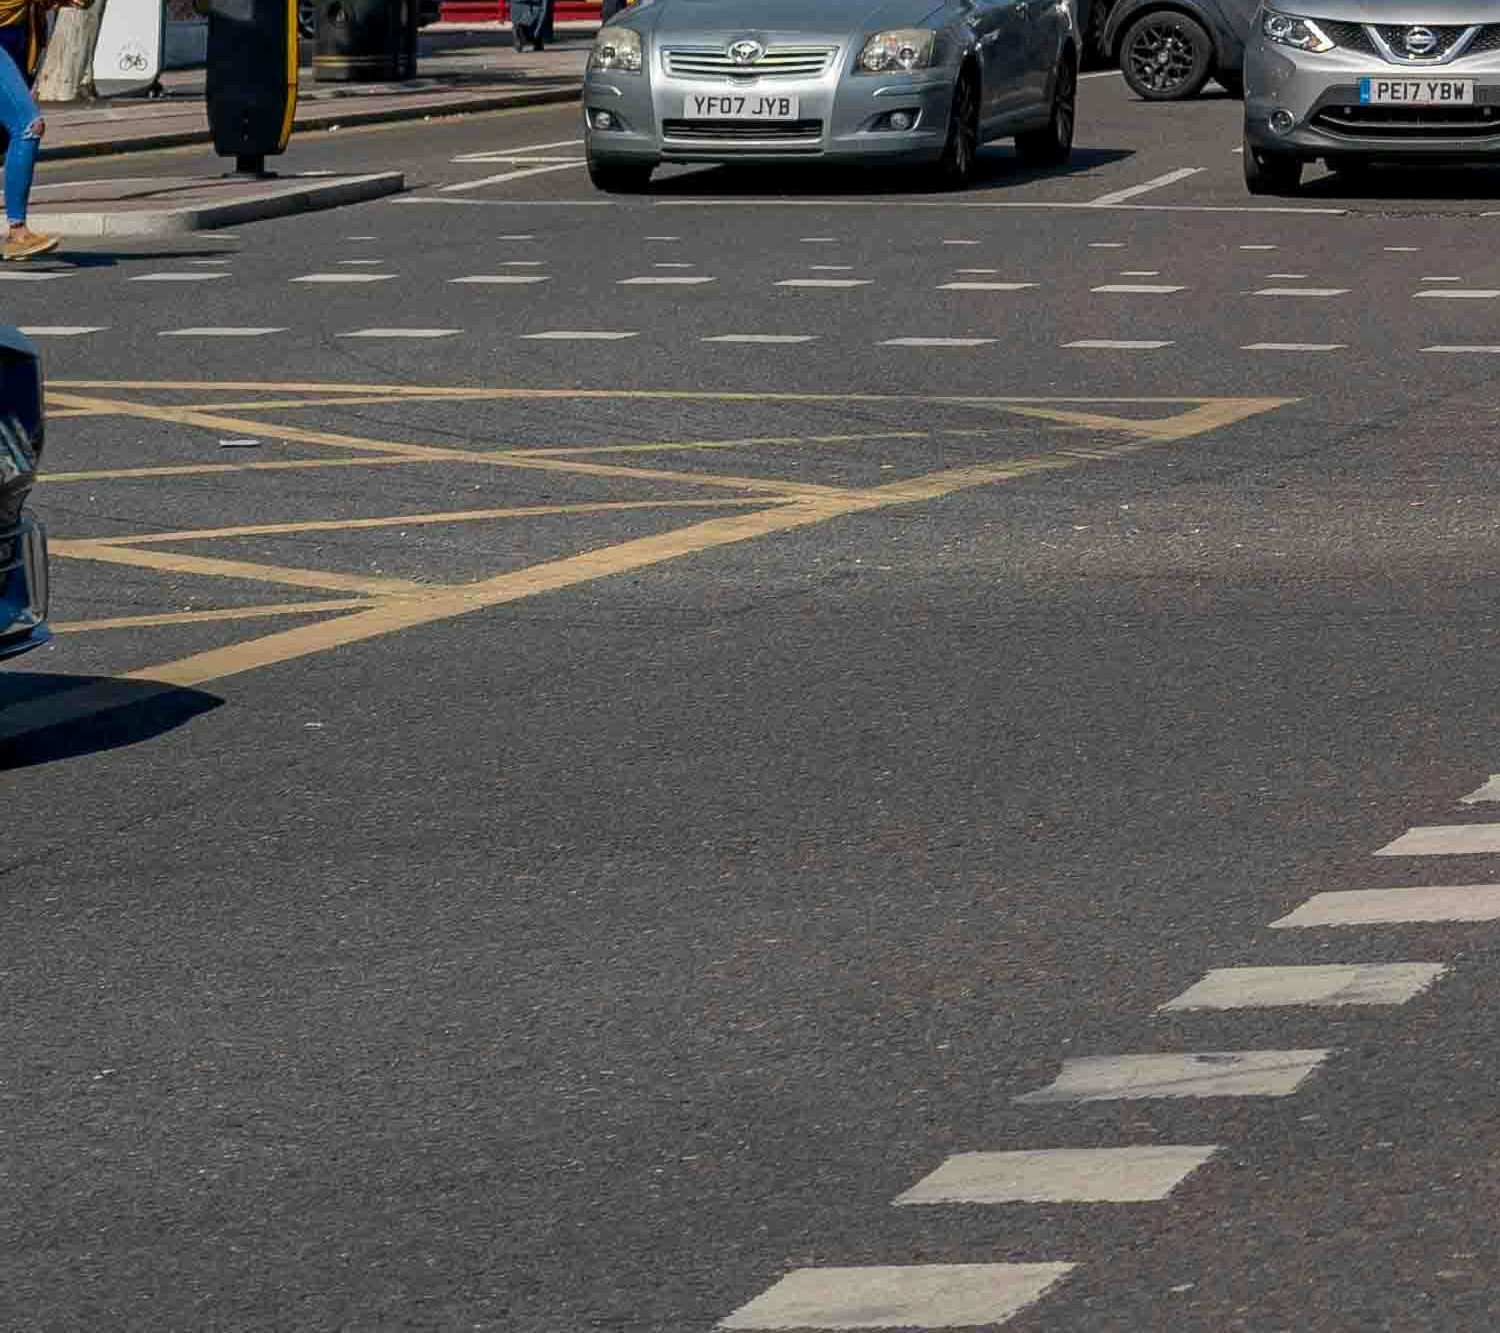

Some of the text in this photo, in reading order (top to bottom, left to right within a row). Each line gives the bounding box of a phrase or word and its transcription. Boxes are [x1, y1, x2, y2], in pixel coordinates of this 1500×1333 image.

[1377, 82, 1465, 100] PE17 YBW
[694, 96, 791, 116] YF07 JYB
